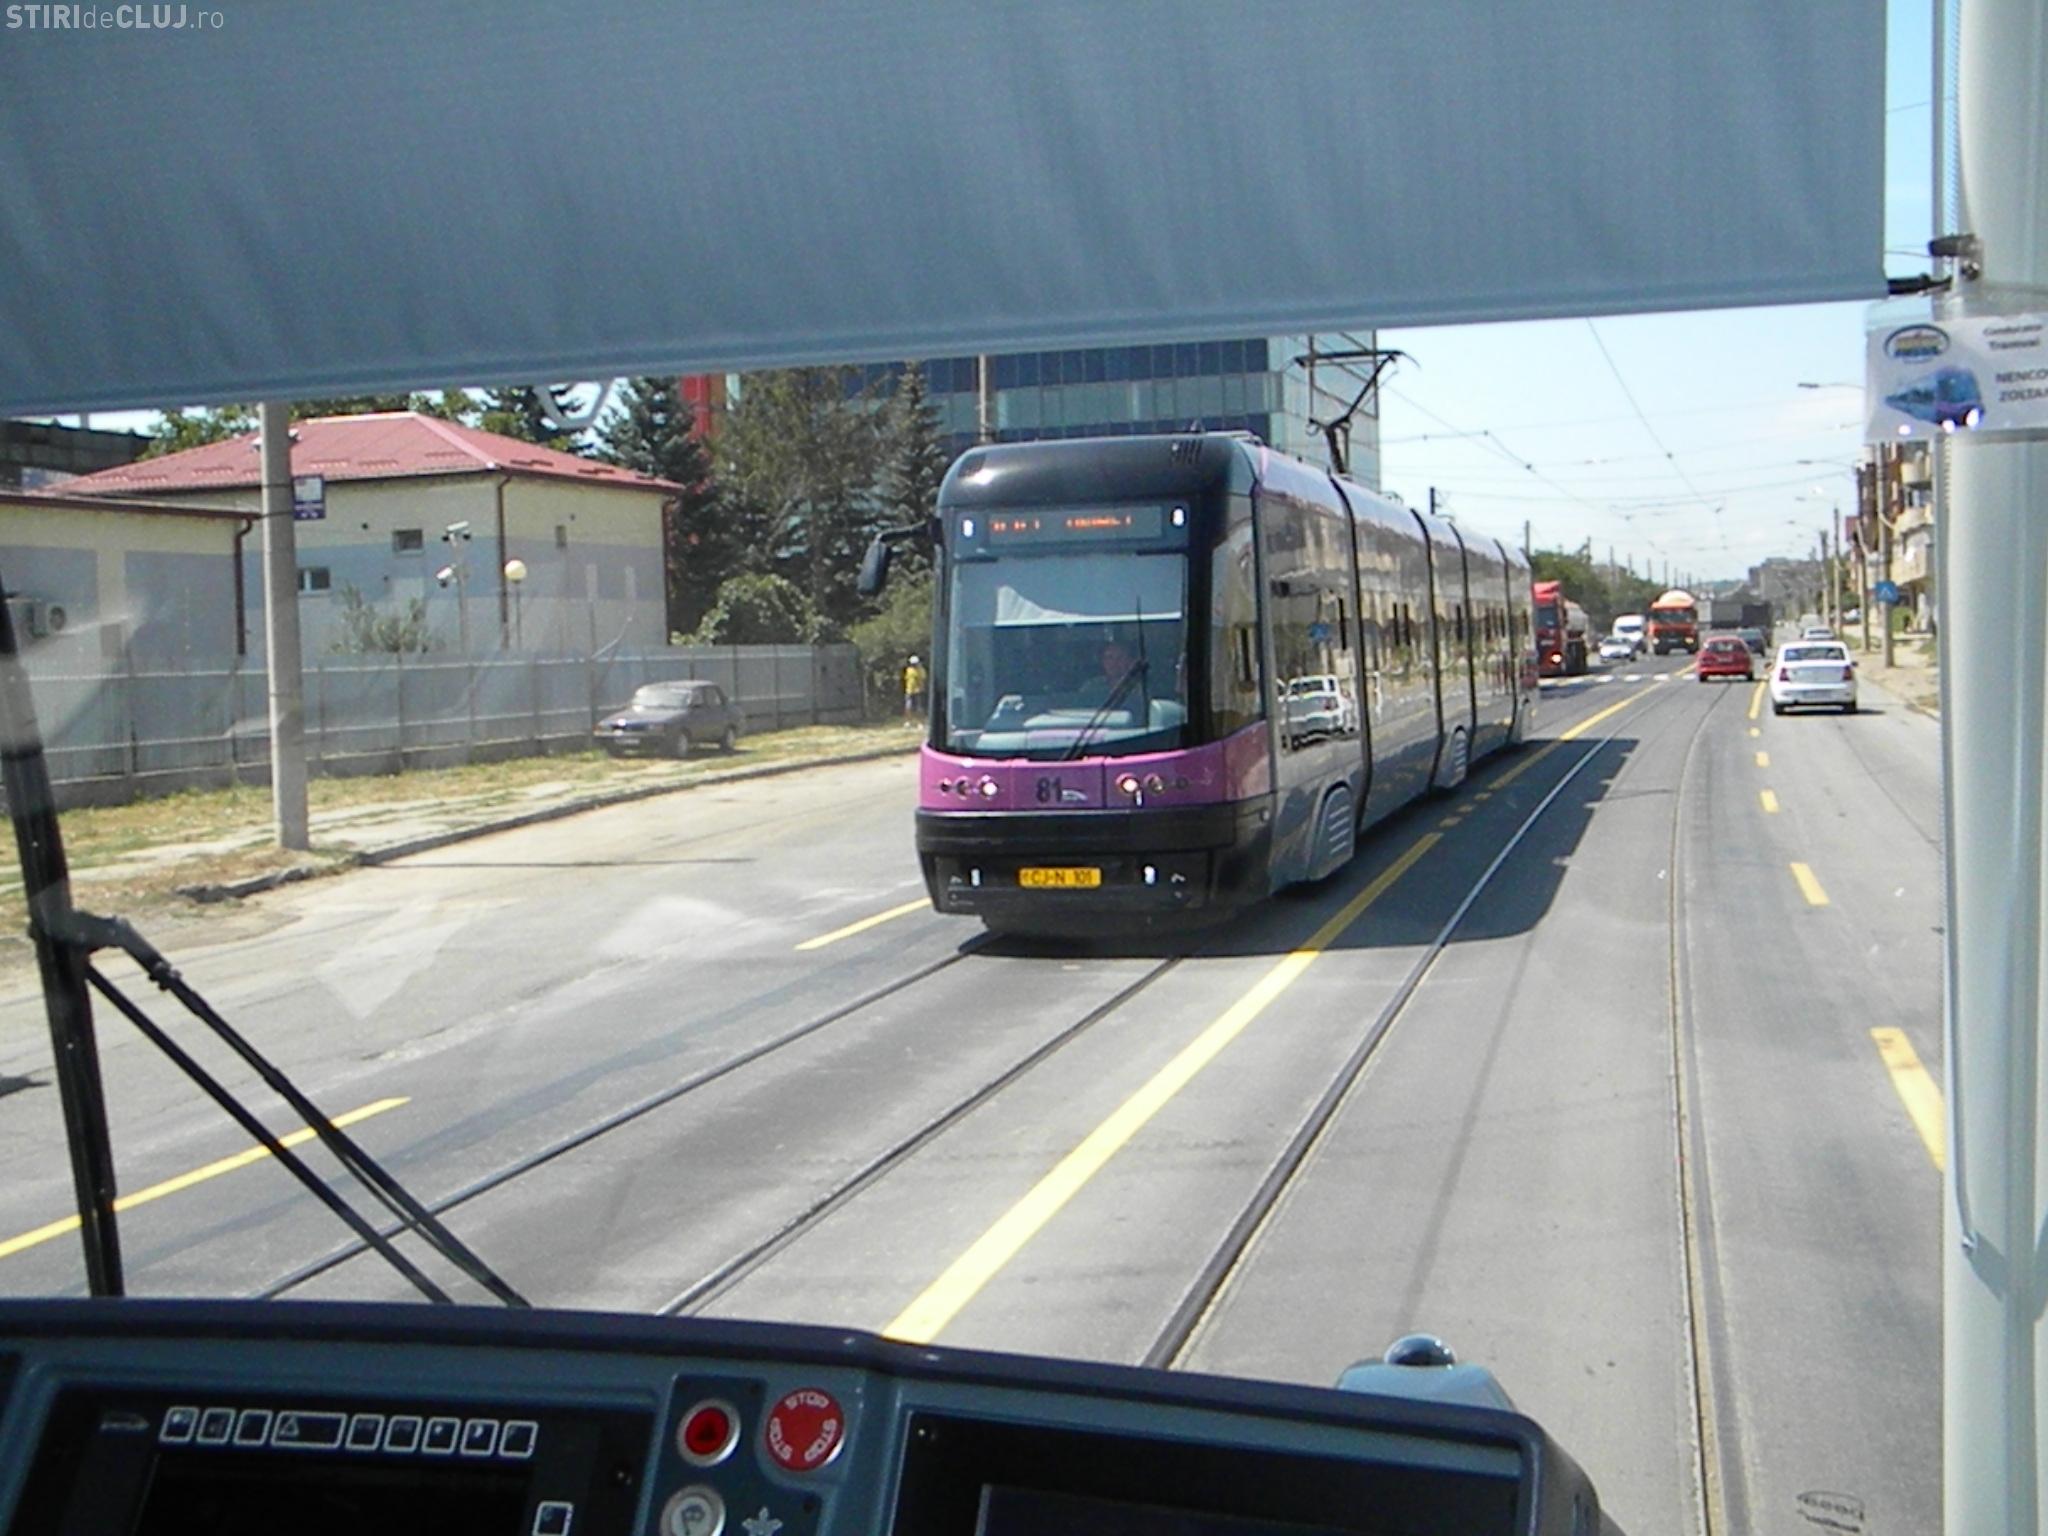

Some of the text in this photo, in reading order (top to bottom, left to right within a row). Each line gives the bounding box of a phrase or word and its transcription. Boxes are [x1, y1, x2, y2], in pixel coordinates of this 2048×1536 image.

[1038, 777, 1062, 802] 81
[784, 1392, 829, 1409] STOP
[769, 1416, 793, 1461] STOP
[804, 1418, 837, 1461] STOP
